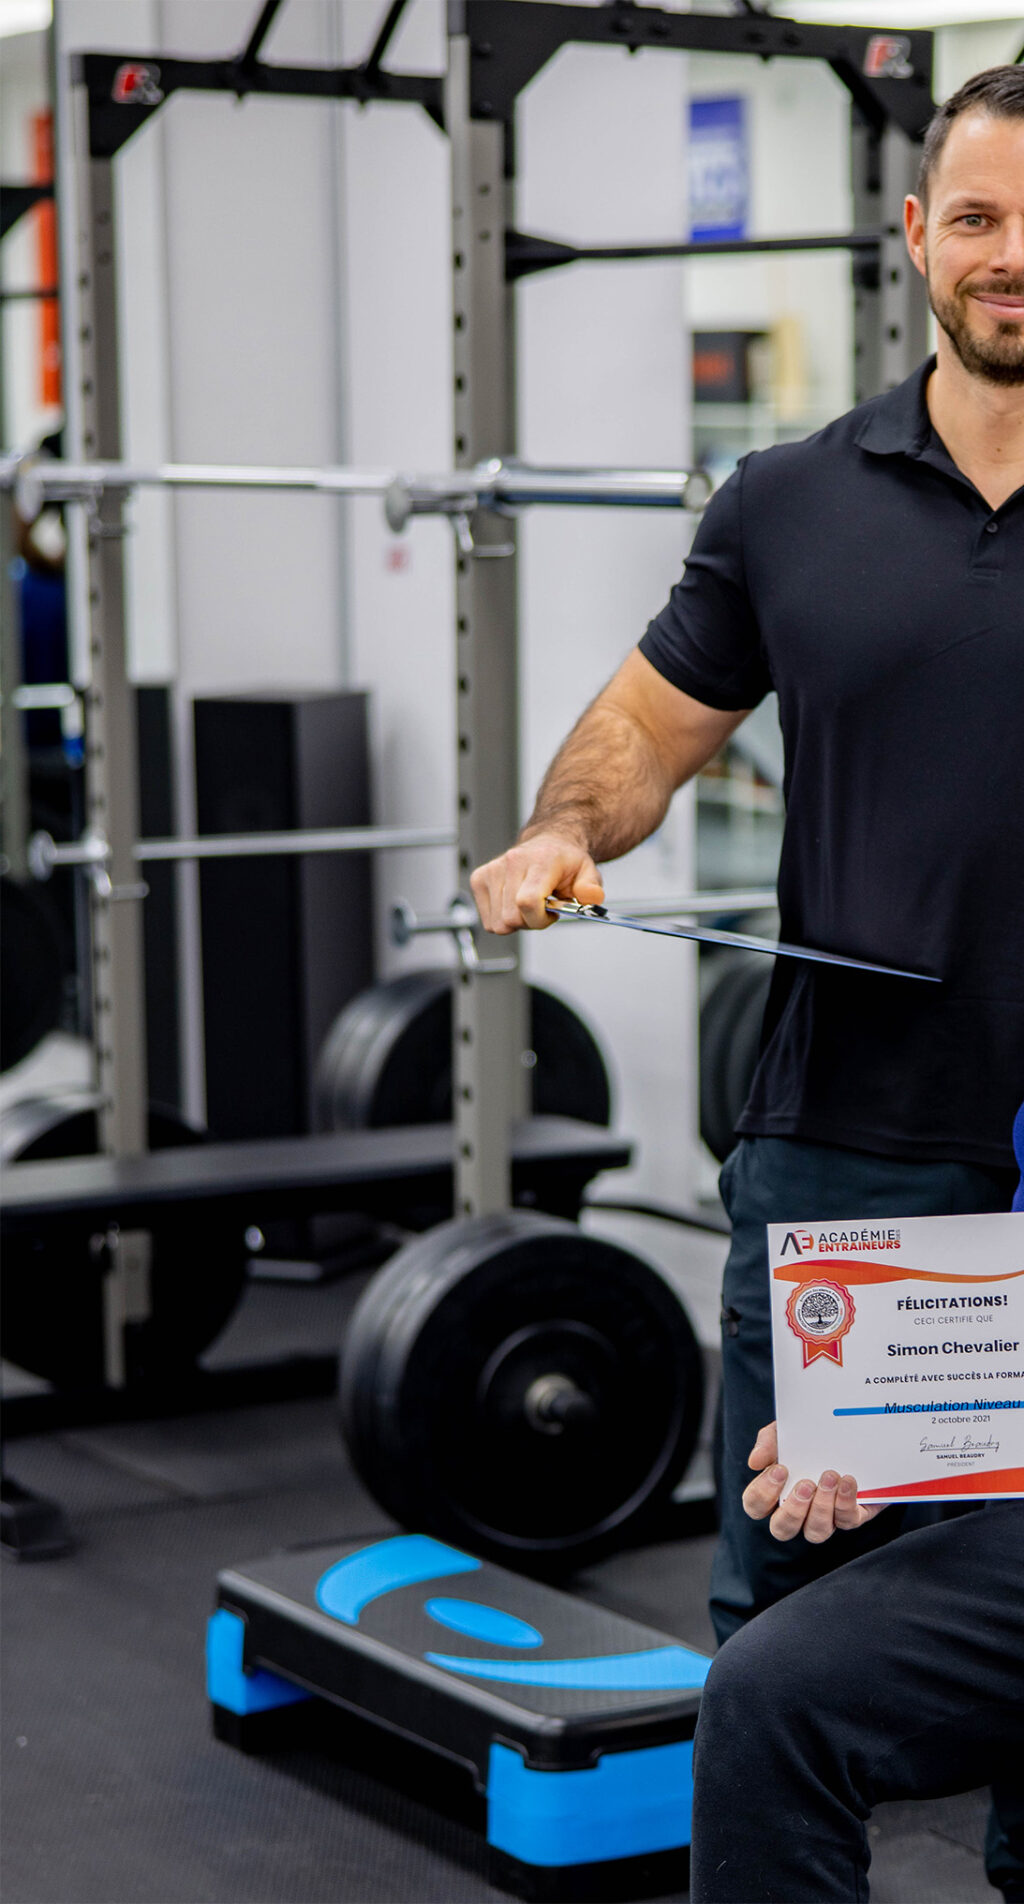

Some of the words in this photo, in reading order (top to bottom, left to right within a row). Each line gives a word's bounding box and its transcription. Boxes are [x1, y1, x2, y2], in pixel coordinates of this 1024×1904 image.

[818, 1228, 895, 1244] ACADÉMIE
[818, 1239, 901, 1253] ENTRAINEURS
[897, 1295, 1009, 1311] FÉLICITATIONS!
[913, 1317, 935, 1326] CECI
[937, 1315, 974, 1325] CERTIFIE
[975, 1314, 994, 1324] QUE
[887, 1343, 939, 1357] Simon
[942, 1339, 1020, 1355] Chevalier
[865, 1377, 872, 1385] A
[873, 1374, 919, 1385] COMPLÉTÉ
[921, 1373, 945, 1383] AVEC
[947, 1371, 981, 1382] SUCCÈS
[983, 1371, 994, 1381] LA
[884, 1400, 970, 1414] Musculation
[973, 1398, 1021, 1411] Niveau
[931, 1416, 937, 1425] 2
[938, 1415, 971, 1424] octobre
[972, 1415, 991, 1423] 2021
